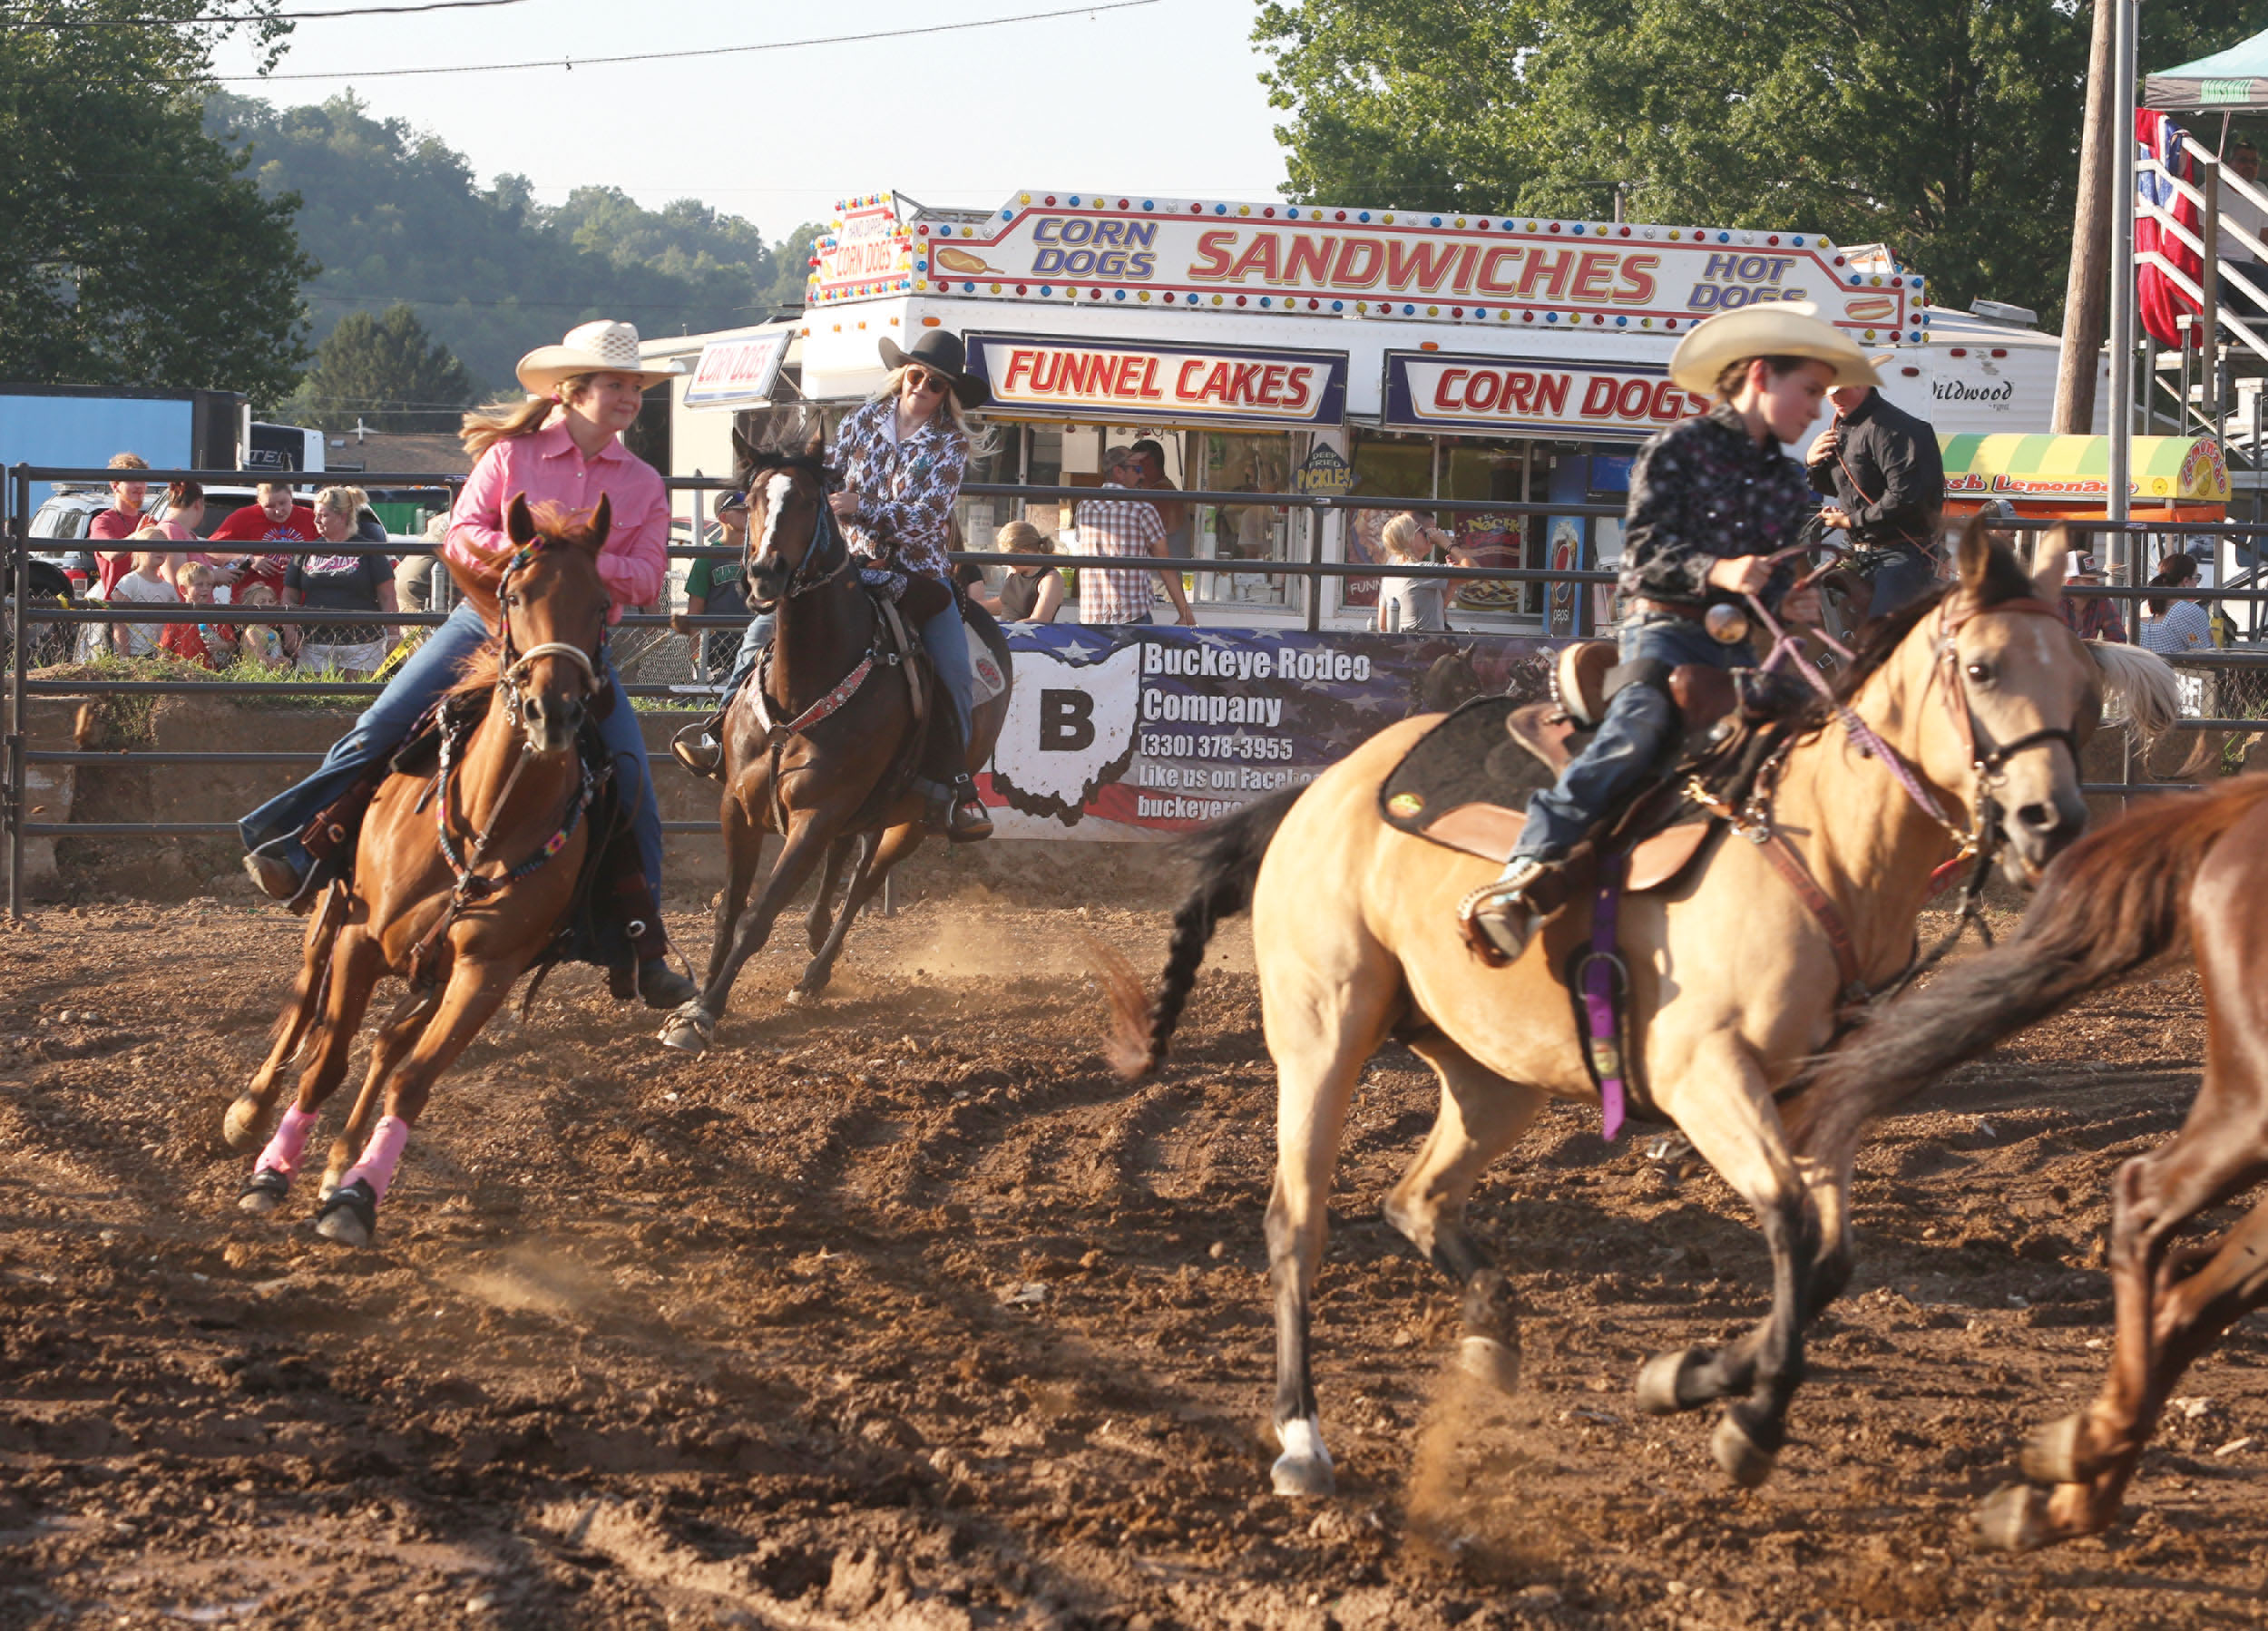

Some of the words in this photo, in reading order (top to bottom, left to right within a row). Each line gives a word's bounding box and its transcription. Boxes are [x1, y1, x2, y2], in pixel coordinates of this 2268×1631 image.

[1031, 218, 1158, 249] CORN
[836, 245, 864, 276] CORN
[865, 239, 892, 272] DOGS
[1031, 248, 1156, 279] DOGS
[1188, 230, 1660, 305] SANDWICHES
[1704, 253, 1796, 283] HOT
[698, 347, 738, 382] CORN
[730, 344, 773, 381] DOGS
[1003, 349, 1163, 400] FUNNEL
[1175, 358, 1315, 409] CAKES
[1434, 367, 1572, 416] CORN
[1580, 375, 1711, 421] DOGS
[1309, 459, 1341, 469] FRIED
[1313, 451, 1336, 460] DEEP
[1298, 467, 1354, 489] PICKLES
[1993, 473, 2140, 494] Lemonae
[1553, 606, 1569, 624] pepsi
[1144, 642, 1271, 680] Buckeye
[1278, 647, 1371, 680] Rodeo
[1039, 689, 1096, 751] B
[1143, 688, 1283, 727] Company
[1140, 733, 1194, 757] (330)
[1198, 736, 1293, 760] 378-3955
[1139, 765, 1178, 787] Like
[1182, 768, 1207, 789] us
[1211, 770, 1237, 790] on
[1240, 767, 1321, 791] Facebo
[1138, 796, 1255, 821] buckeyero
